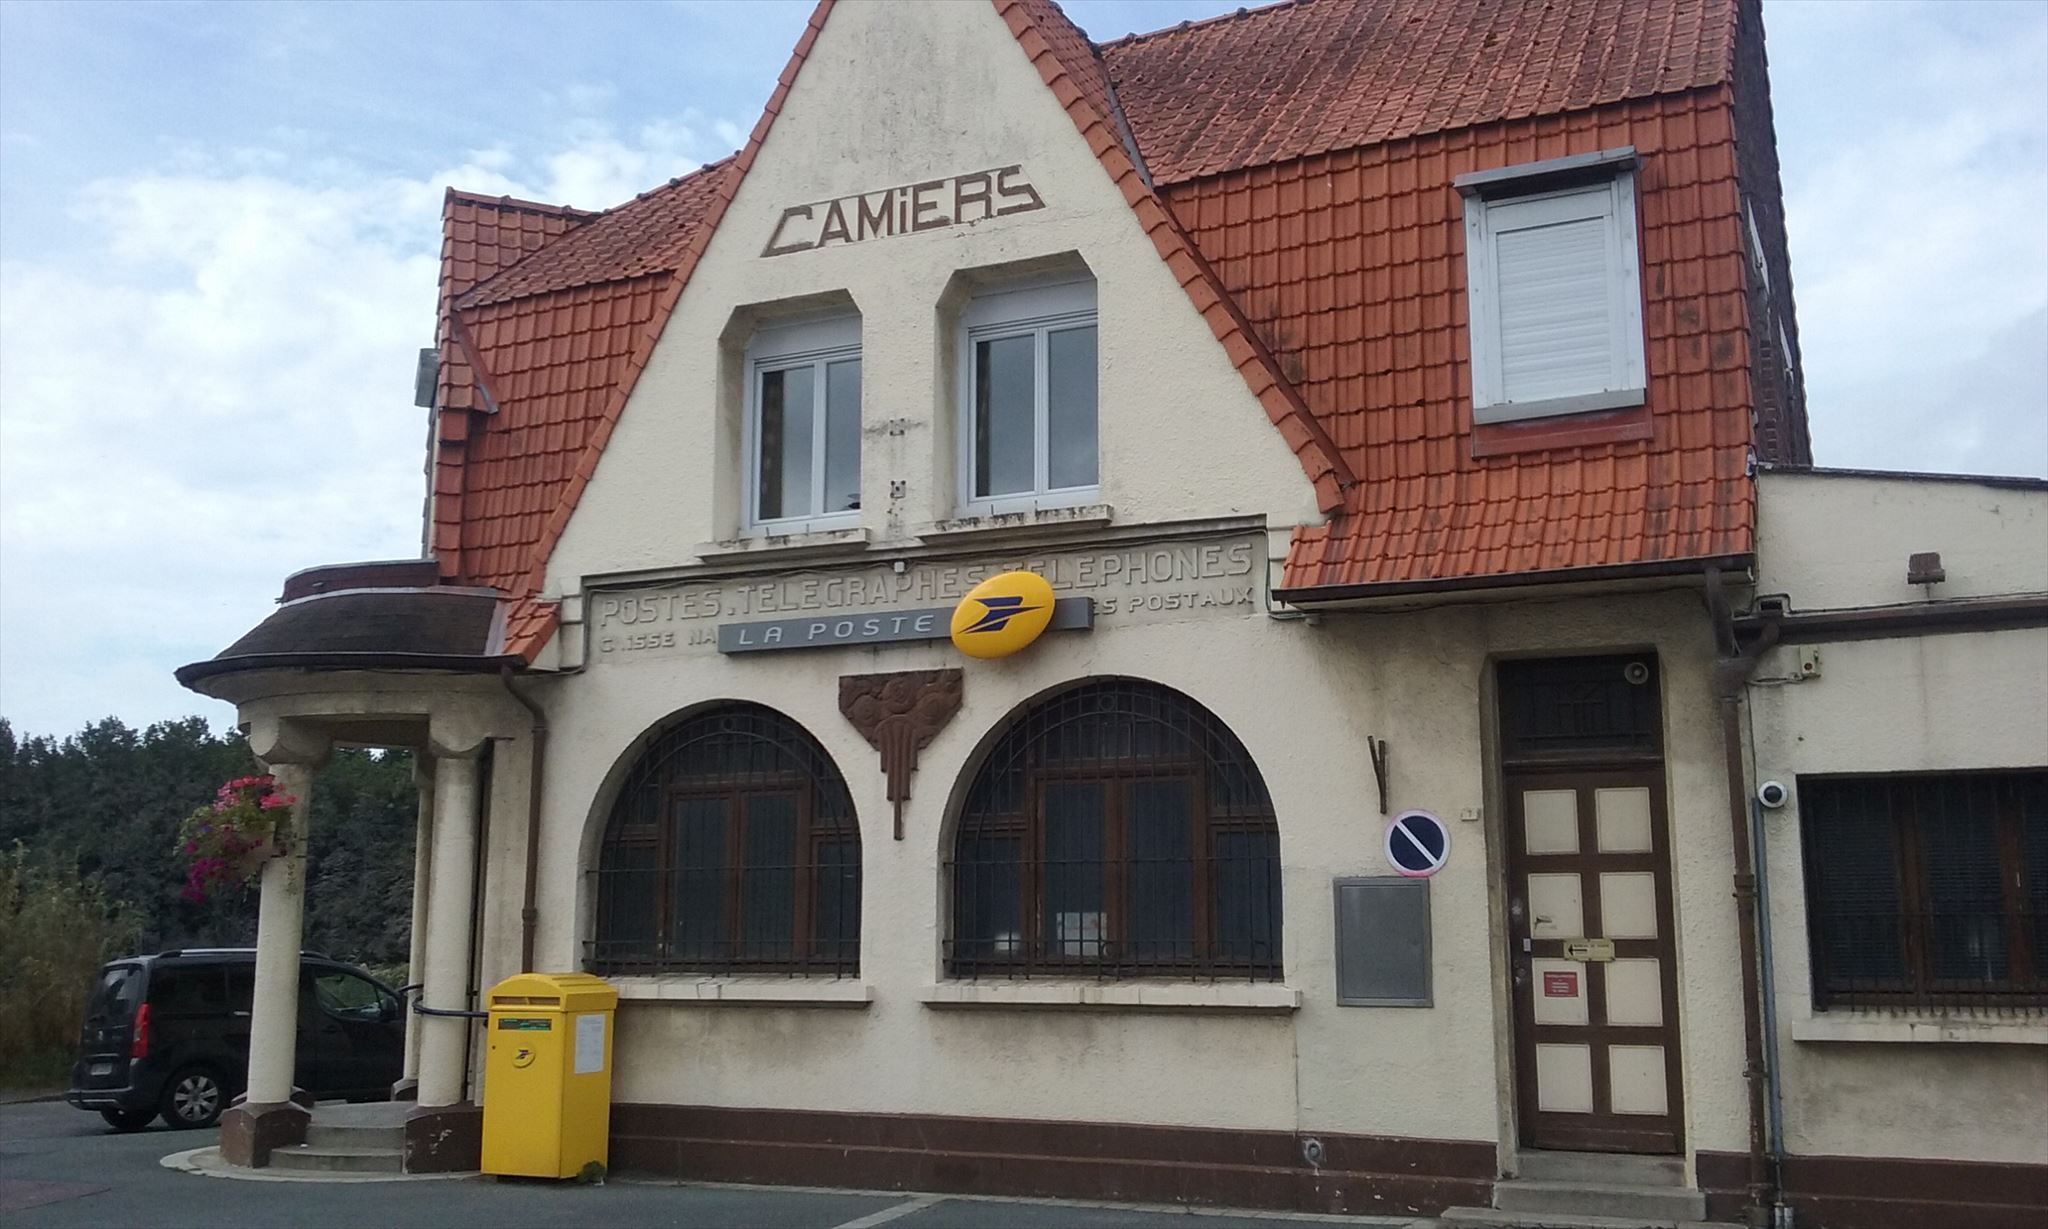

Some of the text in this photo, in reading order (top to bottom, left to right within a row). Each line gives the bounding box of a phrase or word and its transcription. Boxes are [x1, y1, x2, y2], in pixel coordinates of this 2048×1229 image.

[600, 632, 676, 653] CISSE
[1127, 586, 1255, 614] POSTAUX
[738, 614, 934, 646] LA POSTE
